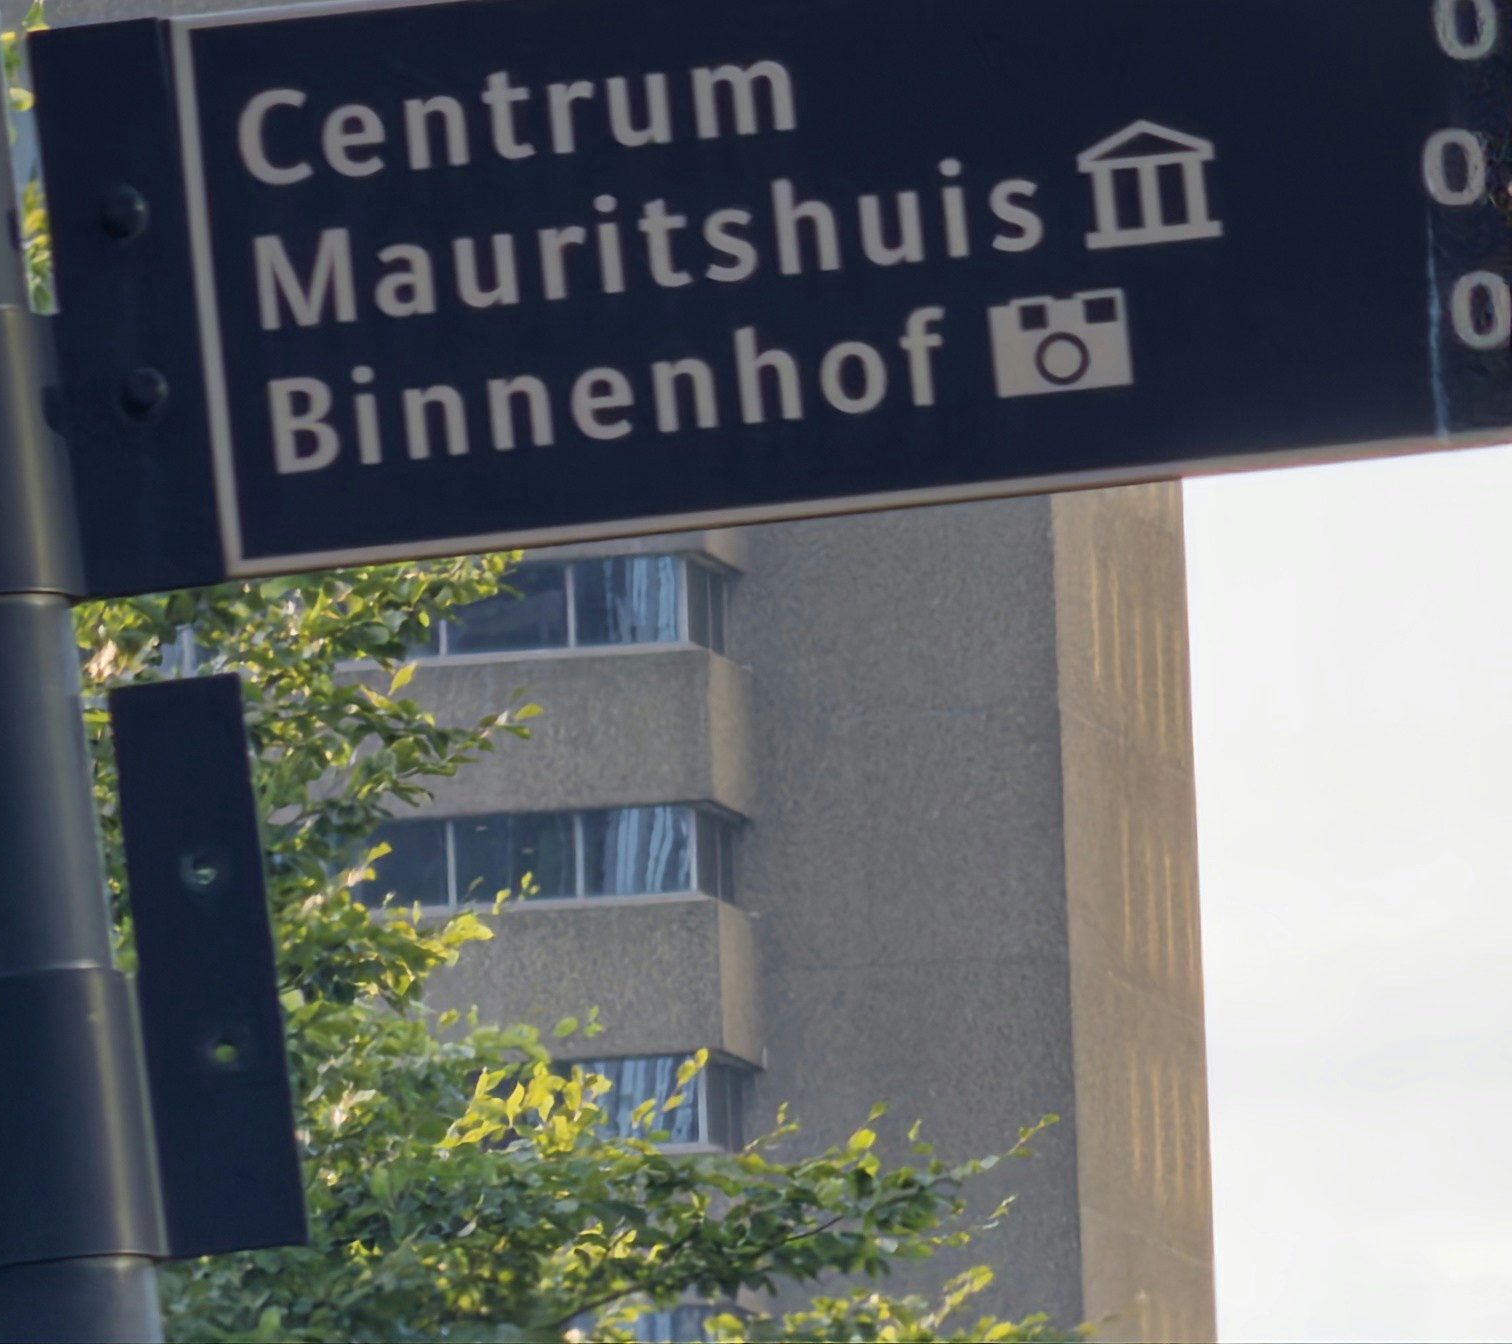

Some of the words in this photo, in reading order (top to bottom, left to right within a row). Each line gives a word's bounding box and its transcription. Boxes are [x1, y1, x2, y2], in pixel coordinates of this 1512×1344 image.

[236, 59, 797, 186] Centrum
[251, 156, 1045, 331] Mauritshuis
[266, 305, 946, 475] Binnenhof
